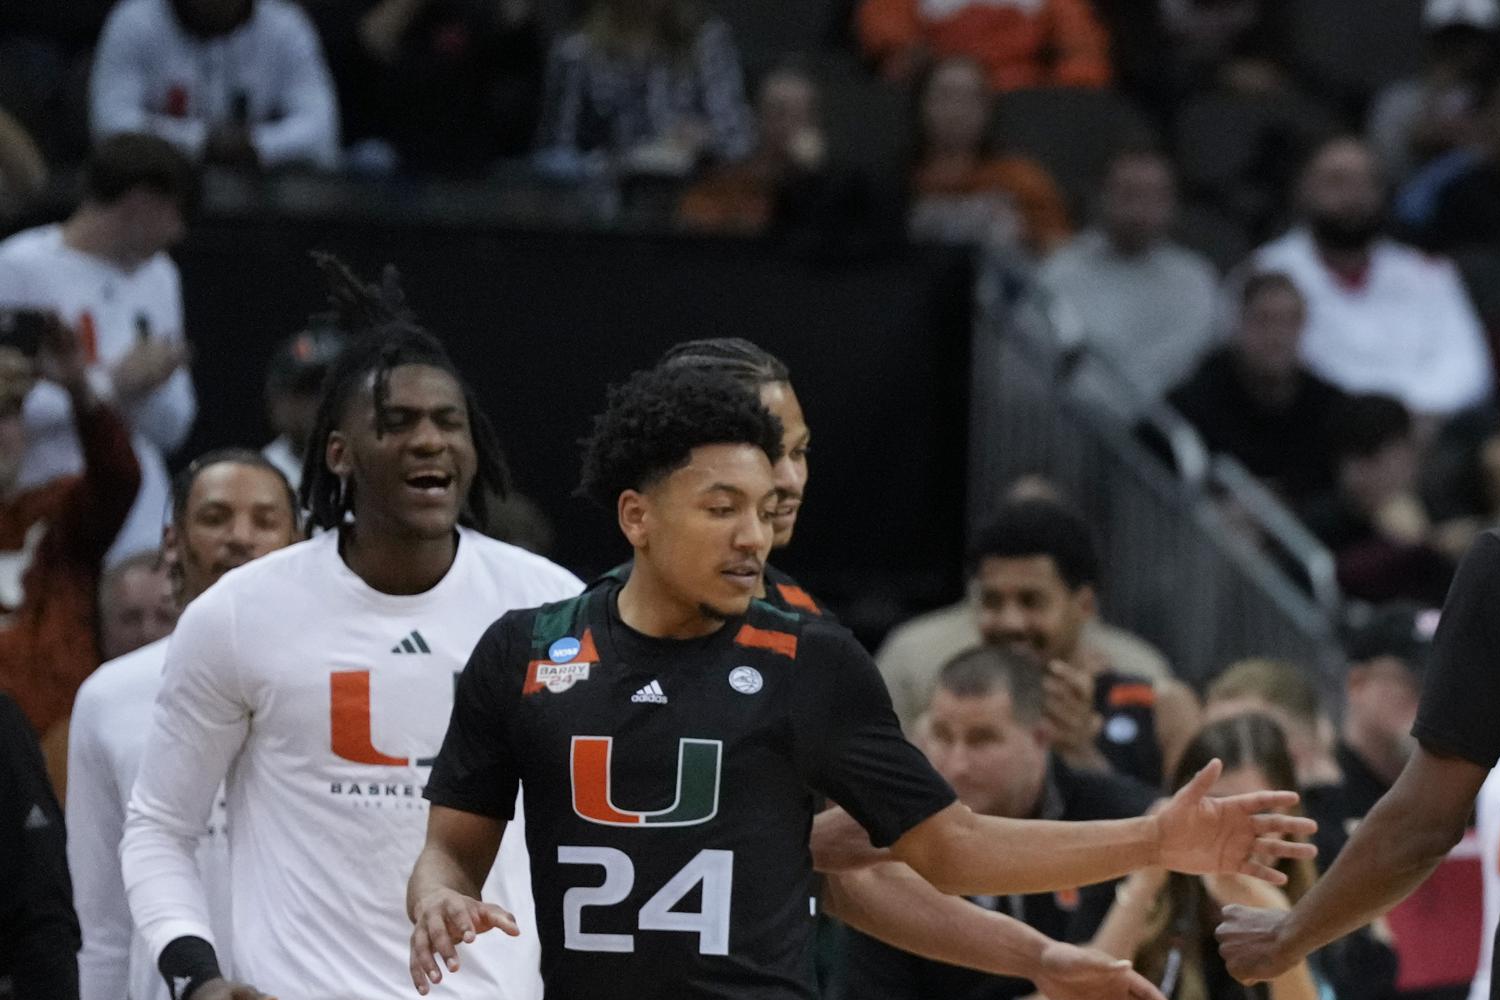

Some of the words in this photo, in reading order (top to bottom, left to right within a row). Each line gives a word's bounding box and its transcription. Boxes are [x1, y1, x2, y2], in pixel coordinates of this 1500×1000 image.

[540, 665, 586, 675] BARRY
[549, 675, 573, 687] 24
[631, 694, 669, 705] adidas
[569, 733, 724, 828] U
[557, 845, 735, 956] 24
